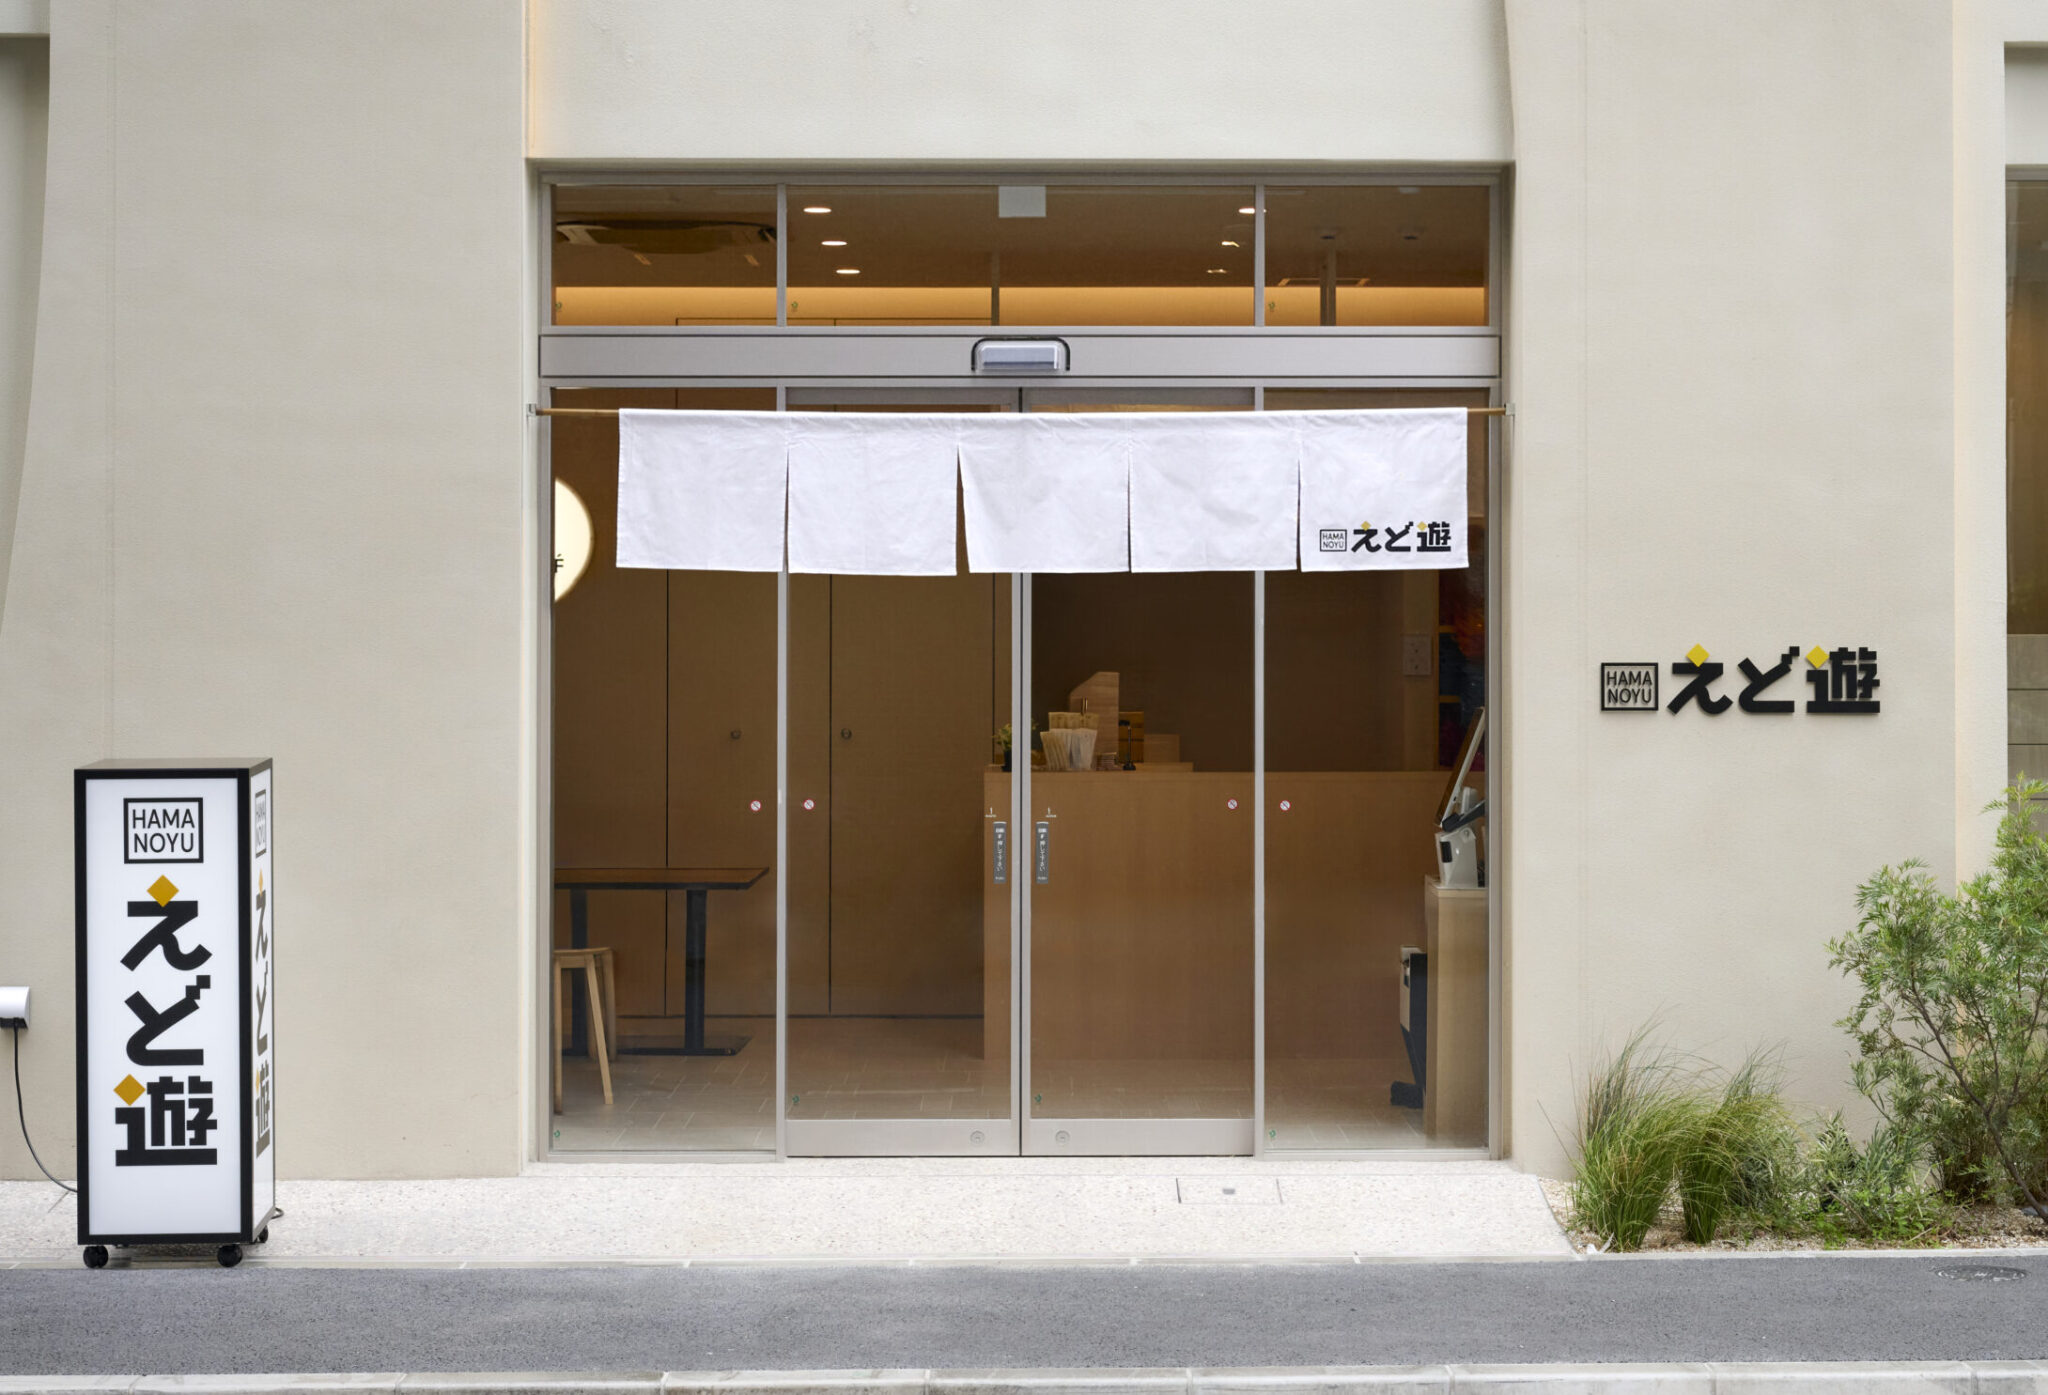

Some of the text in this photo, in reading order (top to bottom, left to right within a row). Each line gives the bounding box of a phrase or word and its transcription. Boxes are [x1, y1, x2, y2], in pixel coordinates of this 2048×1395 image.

[1351, 521, 1452, 553] えど遊
[1606, 671, 1653, 686] HAMA
[1667, 643, 1880, 715] えど遊
[1607, 688, 1653, 704] NOYU
[132, 808, 196, 829] HAMA
[133, 832, 195, 853] NOYU
[113, 874, 218, 1167] えど遊
[255, 867, 271, 1159] えど遊
